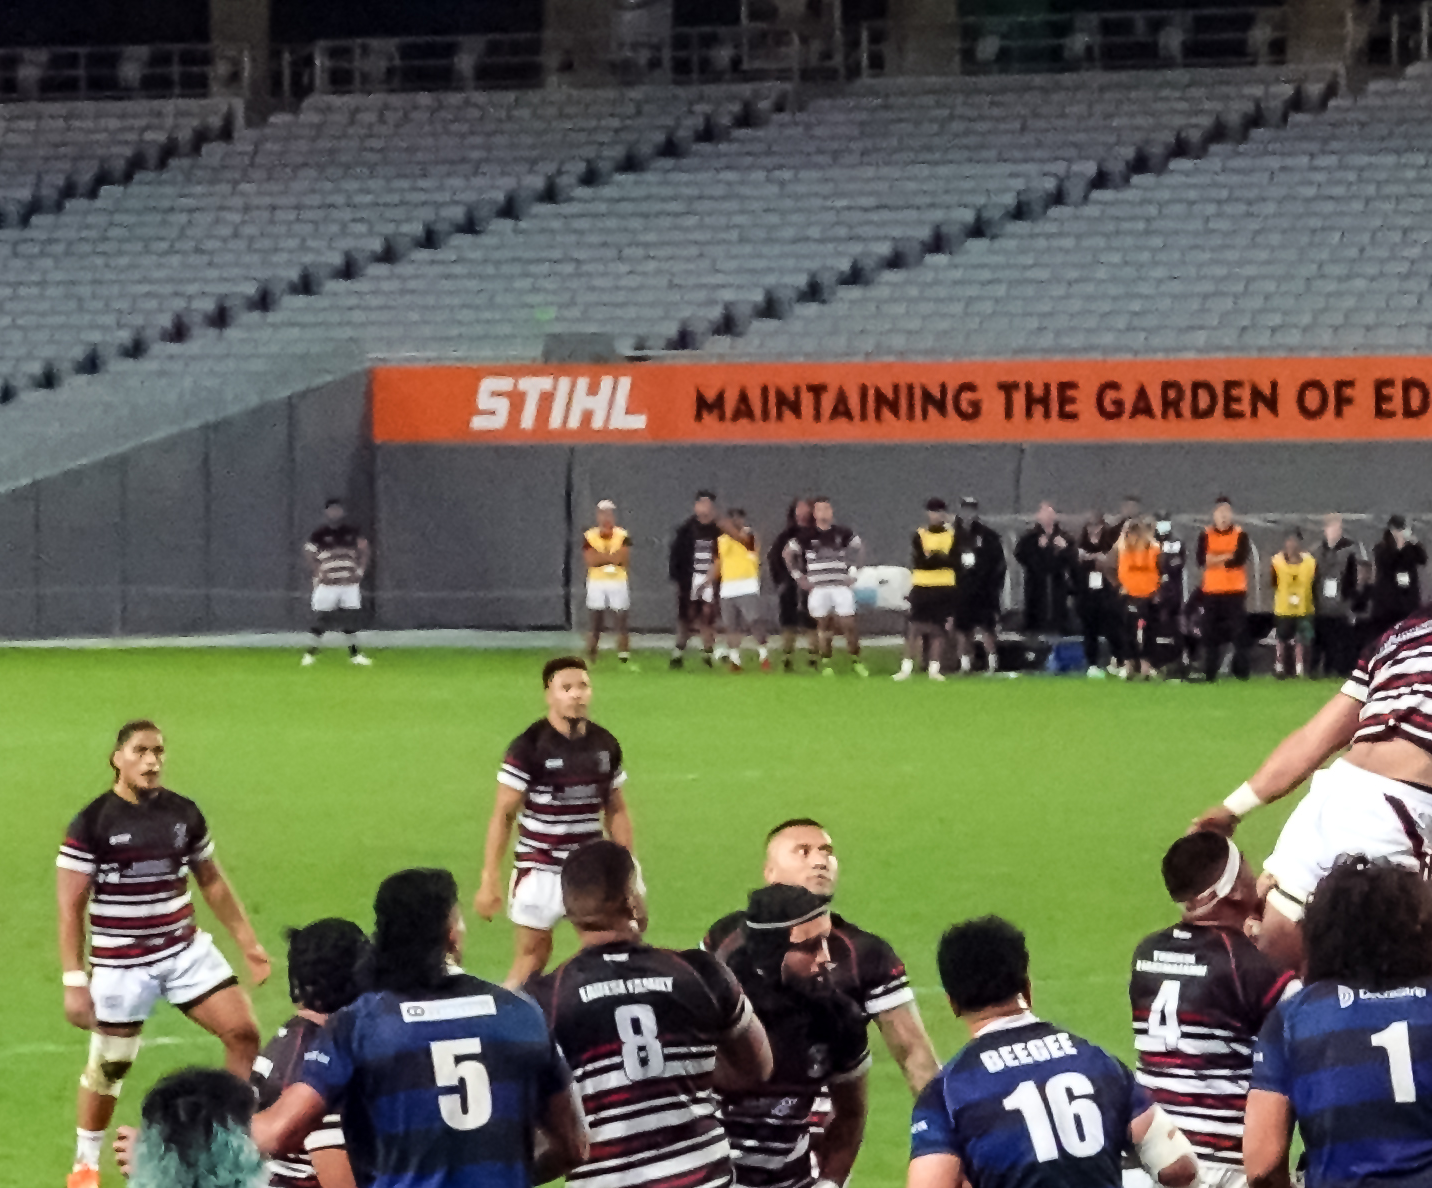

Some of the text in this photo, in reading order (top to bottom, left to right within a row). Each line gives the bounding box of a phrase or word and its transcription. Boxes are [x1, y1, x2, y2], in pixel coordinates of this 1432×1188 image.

[470, 376, 647, 431] STIHL
[693, 382, 982, 422] MAINTAINING
[996, 380, 1080, 421] THE
[1095, 379, 1280, 420] GARDEN
[1297, 378, 1357, 420] OF
[614, 1003, 665, 1081] 8
[1148, 980, 1181, 1050] 4
[429, 1037, 493, 1131] 5
[980, 1032, 1078, 1073] BEEGEE
[1371, 1019, 1416, 1103] 1
[1002, 1071, 1105, 1163] 16
